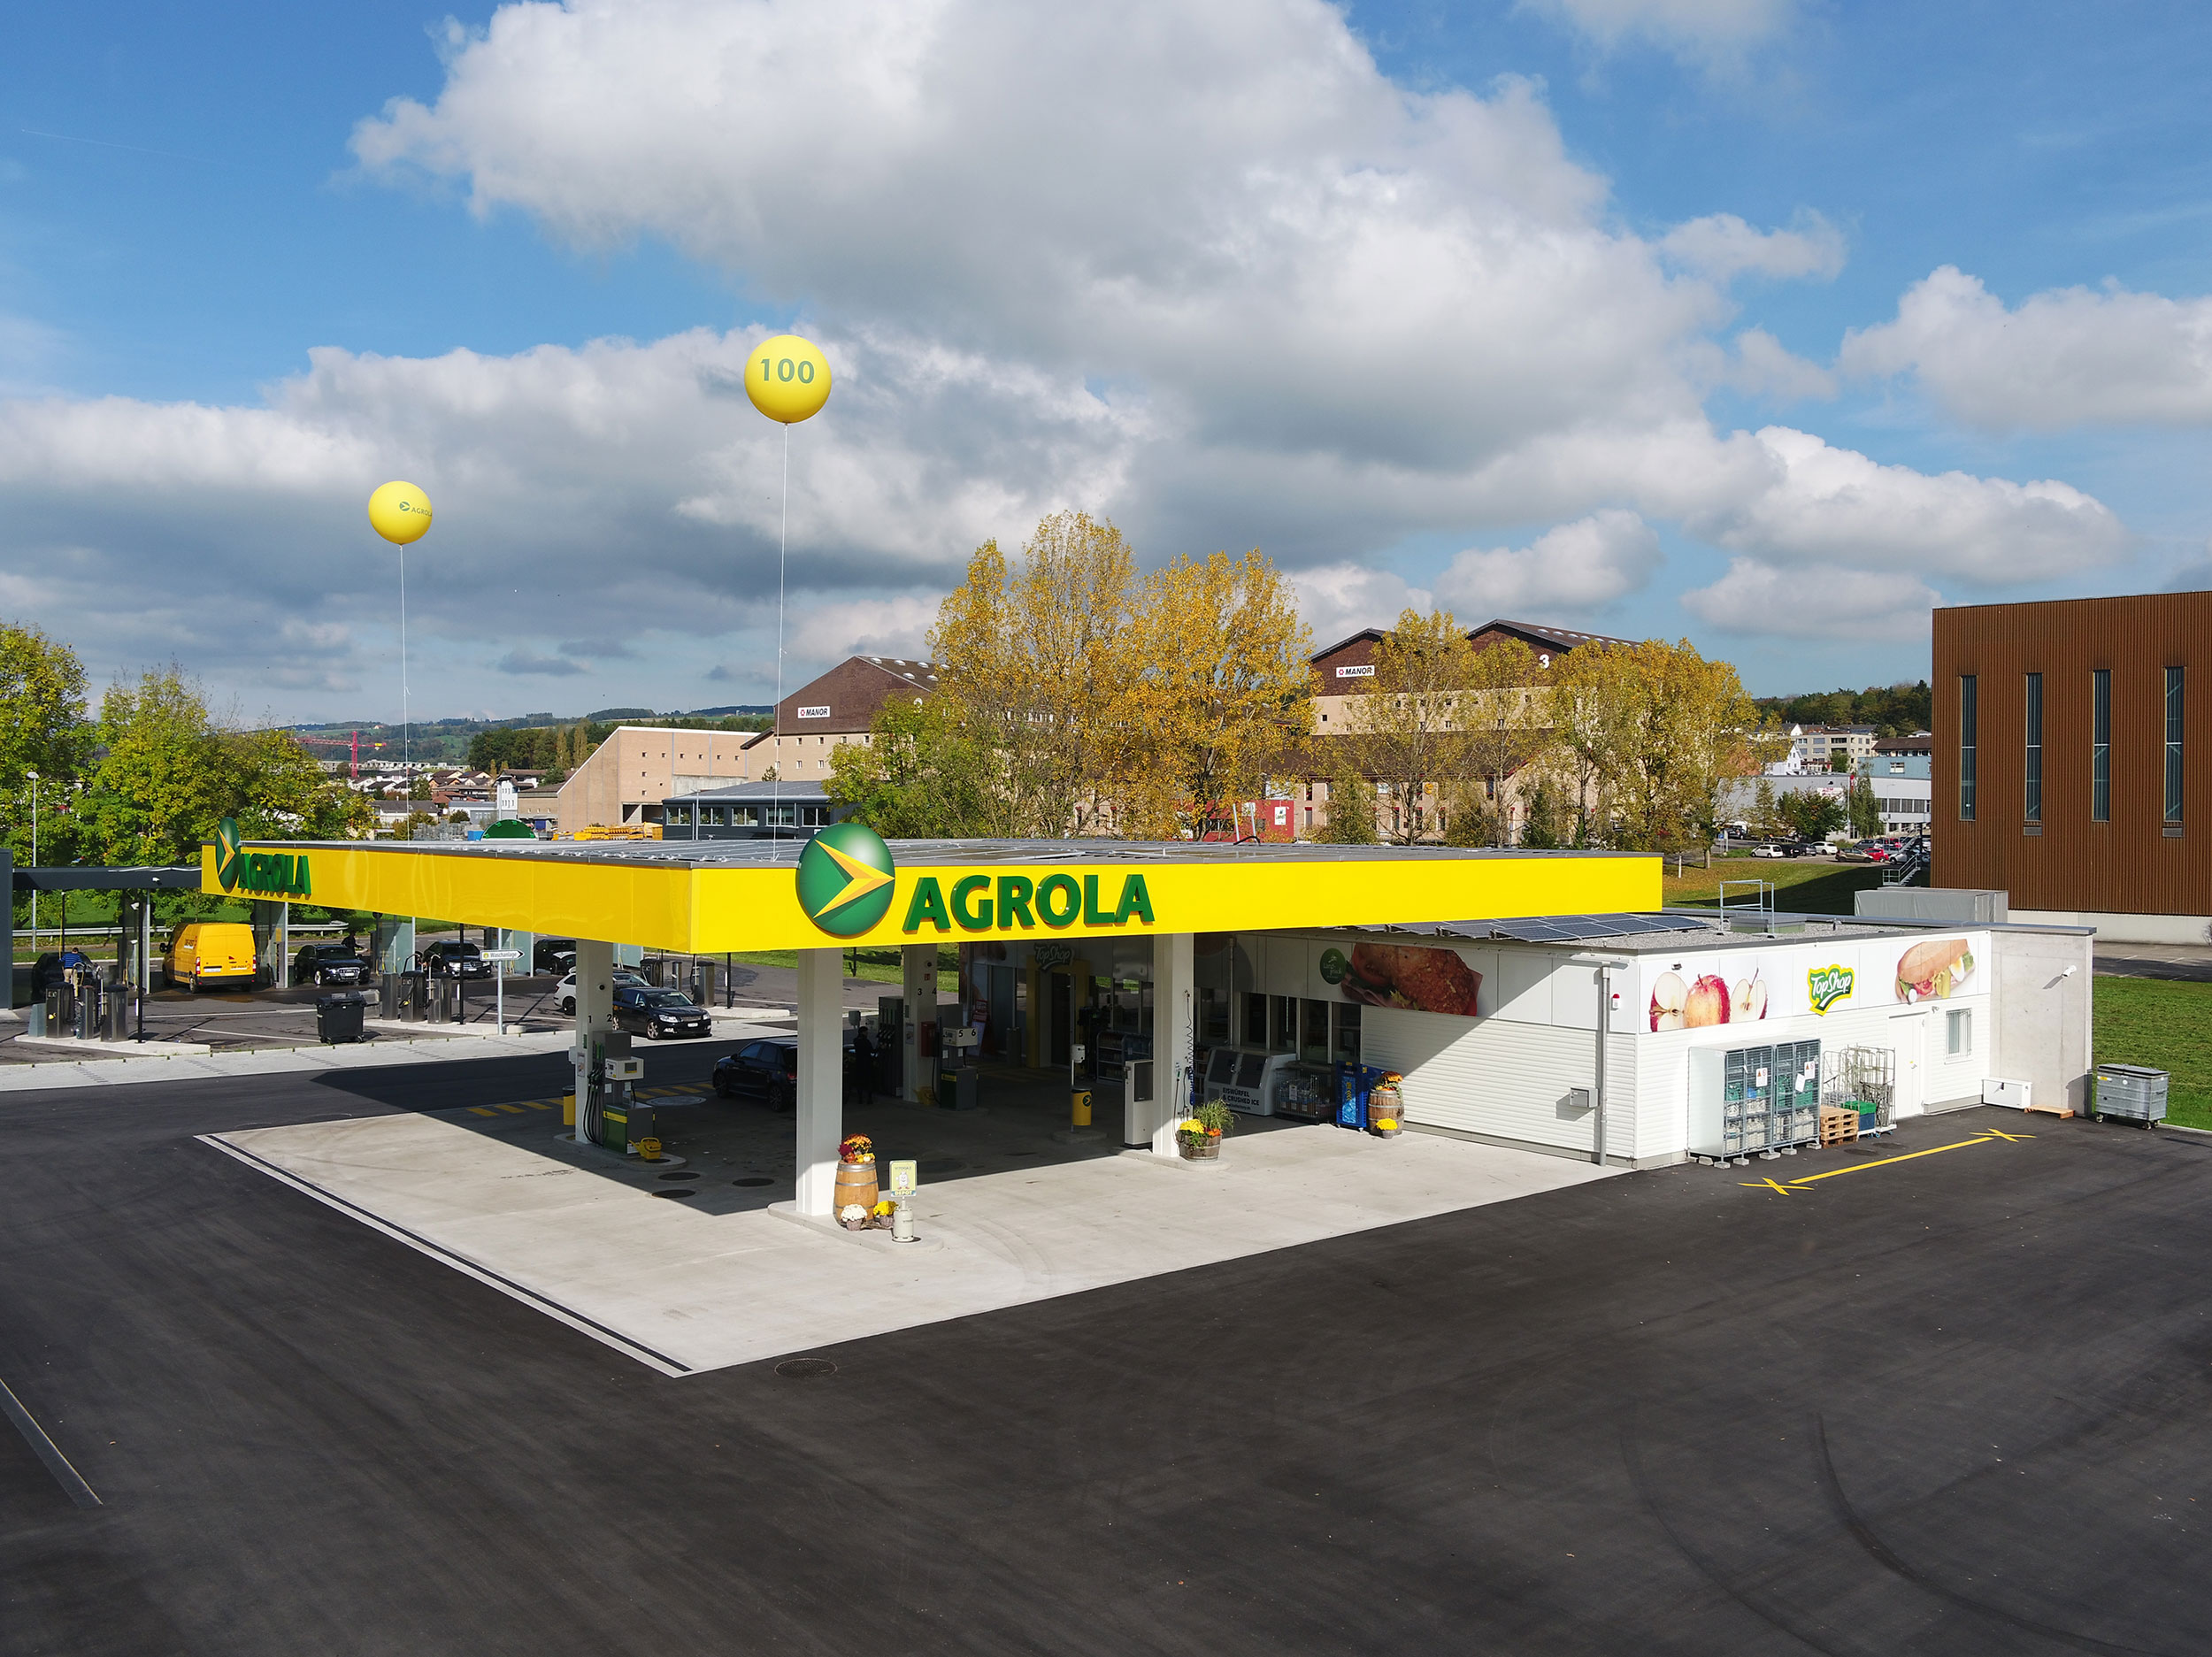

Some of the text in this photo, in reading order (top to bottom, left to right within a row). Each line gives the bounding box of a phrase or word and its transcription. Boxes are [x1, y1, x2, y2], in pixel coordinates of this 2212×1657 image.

[761, 357, 815, 384] 100
[1540, 654, 1549, 669] 3
[806, 708, 827, 717] MANOR
[237, 852, 312, 896] AGROLA
[902, 874, 1156, 933] AGROLA
[1035, 946, 1071, 963] TopShop
[1810, 971, 1851, 999] TopShop
[588, 1015, 592, 1024] 1
[1223, 1087, 1249, 1097] EISWÜRFEL
[1227, 1095, 1251, 1104] CRUSHED
